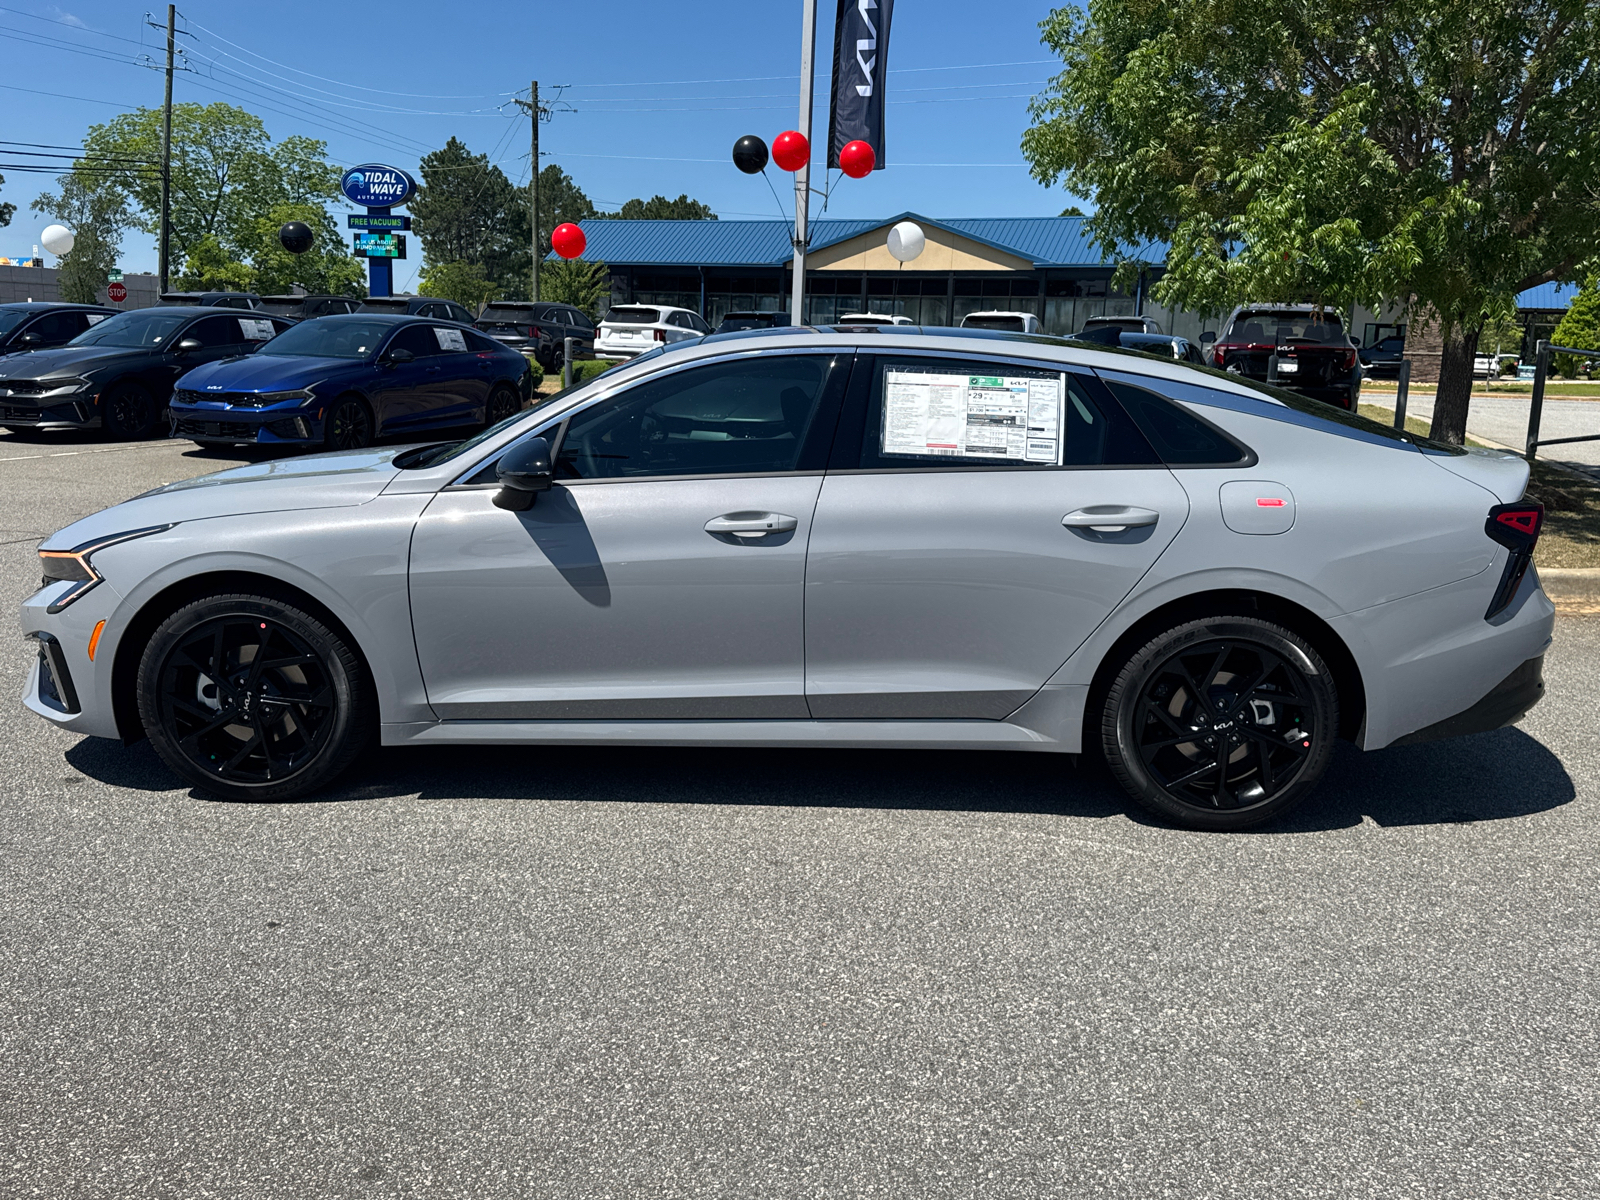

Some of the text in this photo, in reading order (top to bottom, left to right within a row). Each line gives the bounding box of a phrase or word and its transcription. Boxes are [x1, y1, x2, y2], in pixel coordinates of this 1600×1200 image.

[364, 172, 397, 184] TIDAL
[370, 183, 404, 195] WAVE
[350, 218, 402, 226] FREE VACUUMS
[108, 288, 127, 297] STOP
[1213, 720, 1234, 731] KIA
